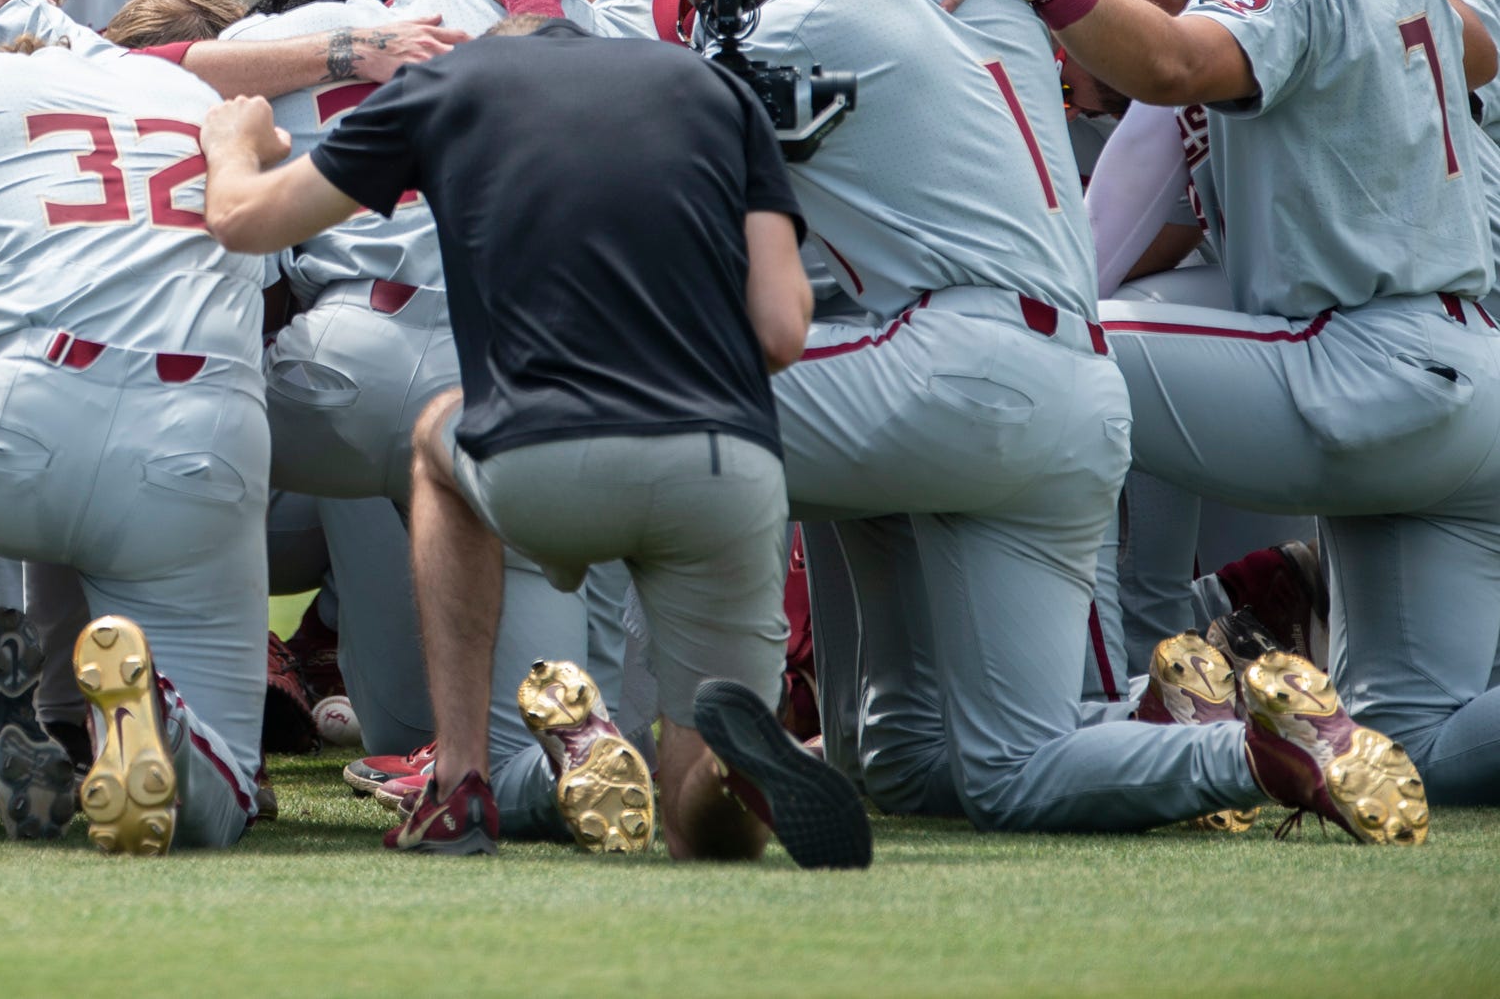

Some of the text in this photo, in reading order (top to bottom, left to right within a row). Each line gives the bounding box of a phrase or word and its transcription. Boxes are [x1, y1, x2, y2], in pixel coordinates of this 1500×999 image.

[24, 111, 214, 233] 32
[980, 58, 1062, 215] 1
[1398, 12, 1461, 179] 7
